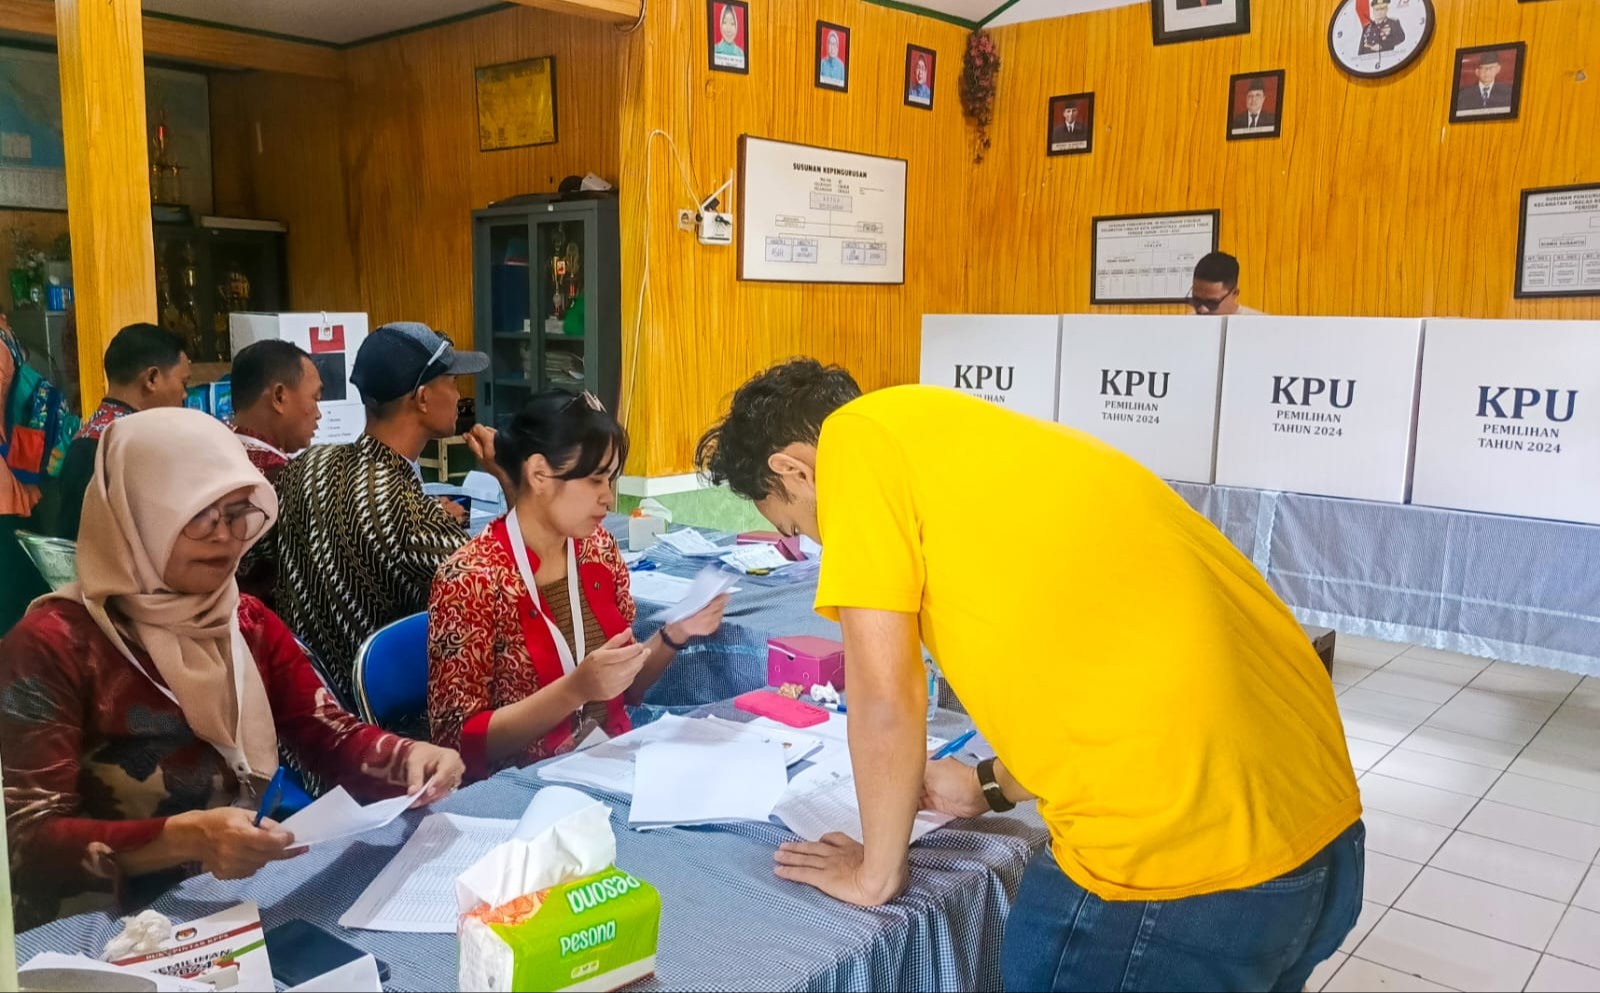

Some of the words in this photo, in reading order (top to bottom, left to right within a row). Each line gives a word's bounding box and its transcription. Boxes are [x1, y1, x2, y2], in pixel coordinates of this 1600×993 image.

[793, 162, 821, 173] SUSUNAN
[823, 168, 867, 178] KEPENGURUSAN
[954, 364, 1015, 391] KPU
[1100, 369, 1170, 398] KPU
[1270, 376, 1357, 408] KPU
[1105, 400, 1158, 411] PEMILIHAN
[1475, 386, 1579, 422] KPU
[1102, 412, 1133, 422] TAHUN
[1135, 414, 1160, 424] 2024
[1276, 410, 1341, 423] PEMILIHAN
[1272, 423, 1311, 434] TAHUN
[1314, 426, 1343, 437] 2024
[1483, 423, 1560, 438] PEMILIHAN
[1478, 438, 1523, 450] TAHUN
[1527, 442, 1561, 454] 2024
[151, 949, 231, 975] EMILIHAN
